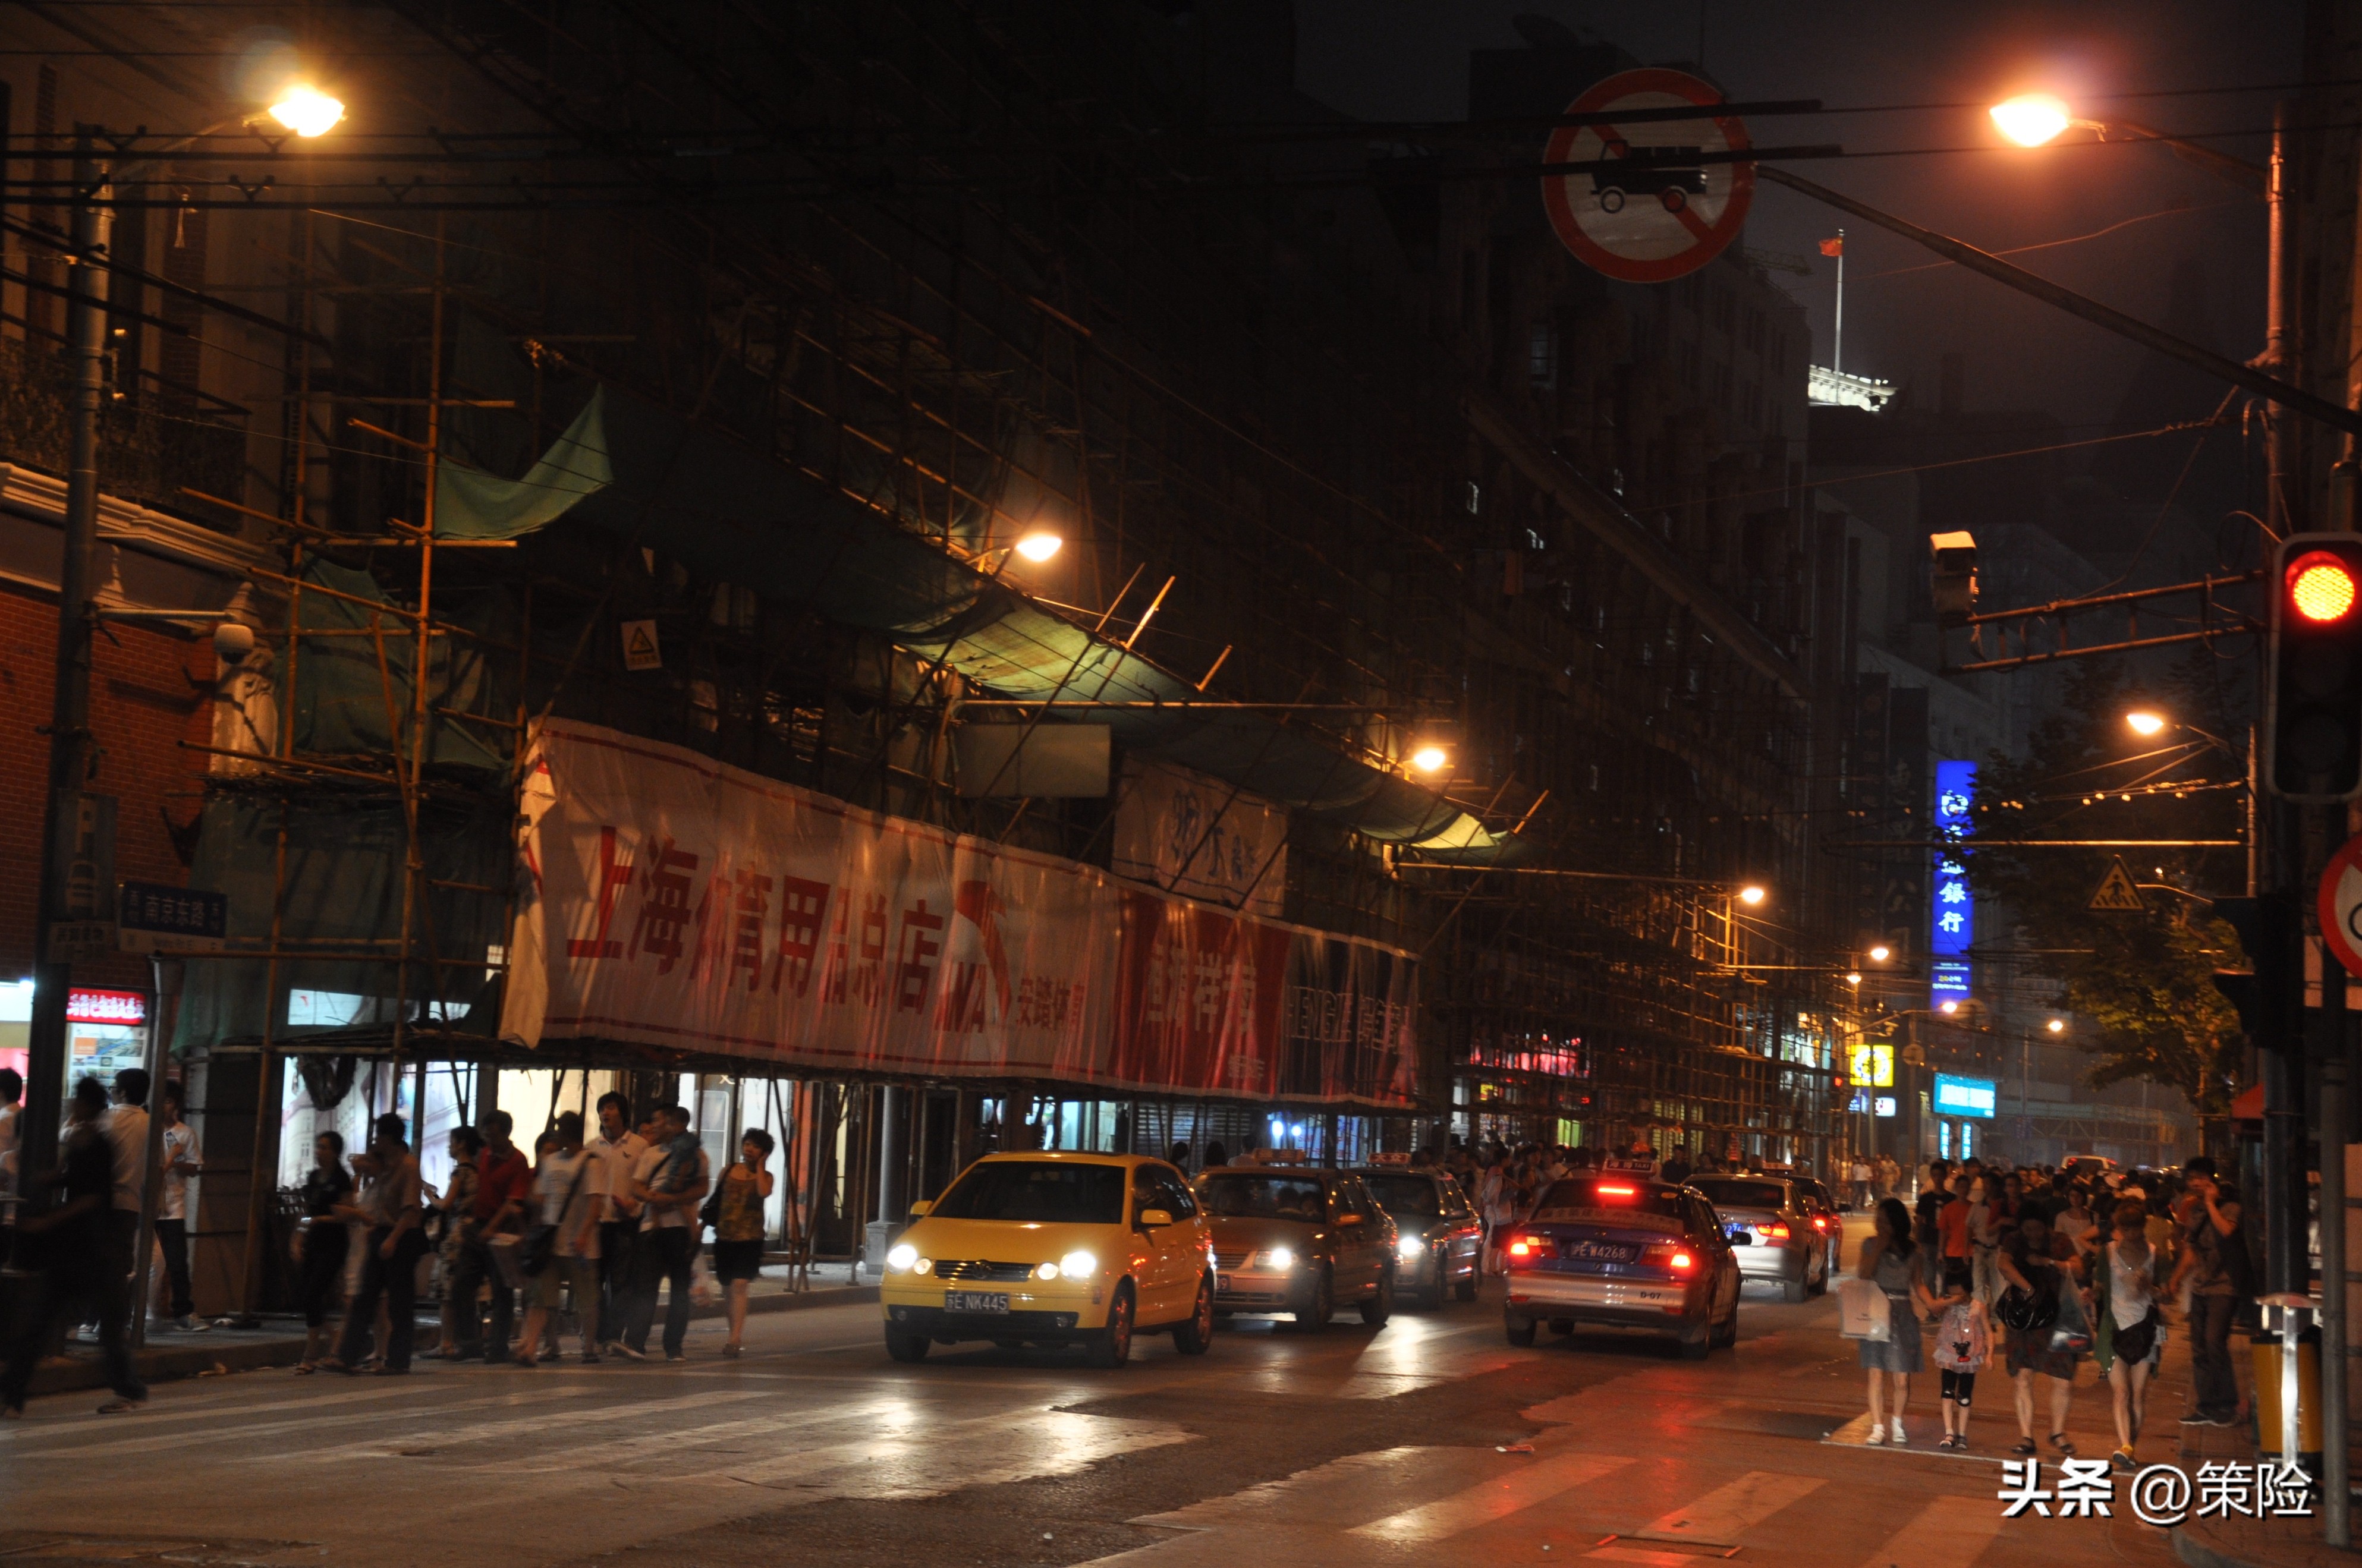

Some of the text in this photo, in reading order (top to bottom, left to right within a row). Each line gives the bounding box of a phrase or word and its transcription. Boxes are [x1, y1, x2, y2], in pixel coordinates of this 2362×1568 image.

[145, 893, 205, 928] 南京东路
[965, 1295, 1007, 1311] NK445
